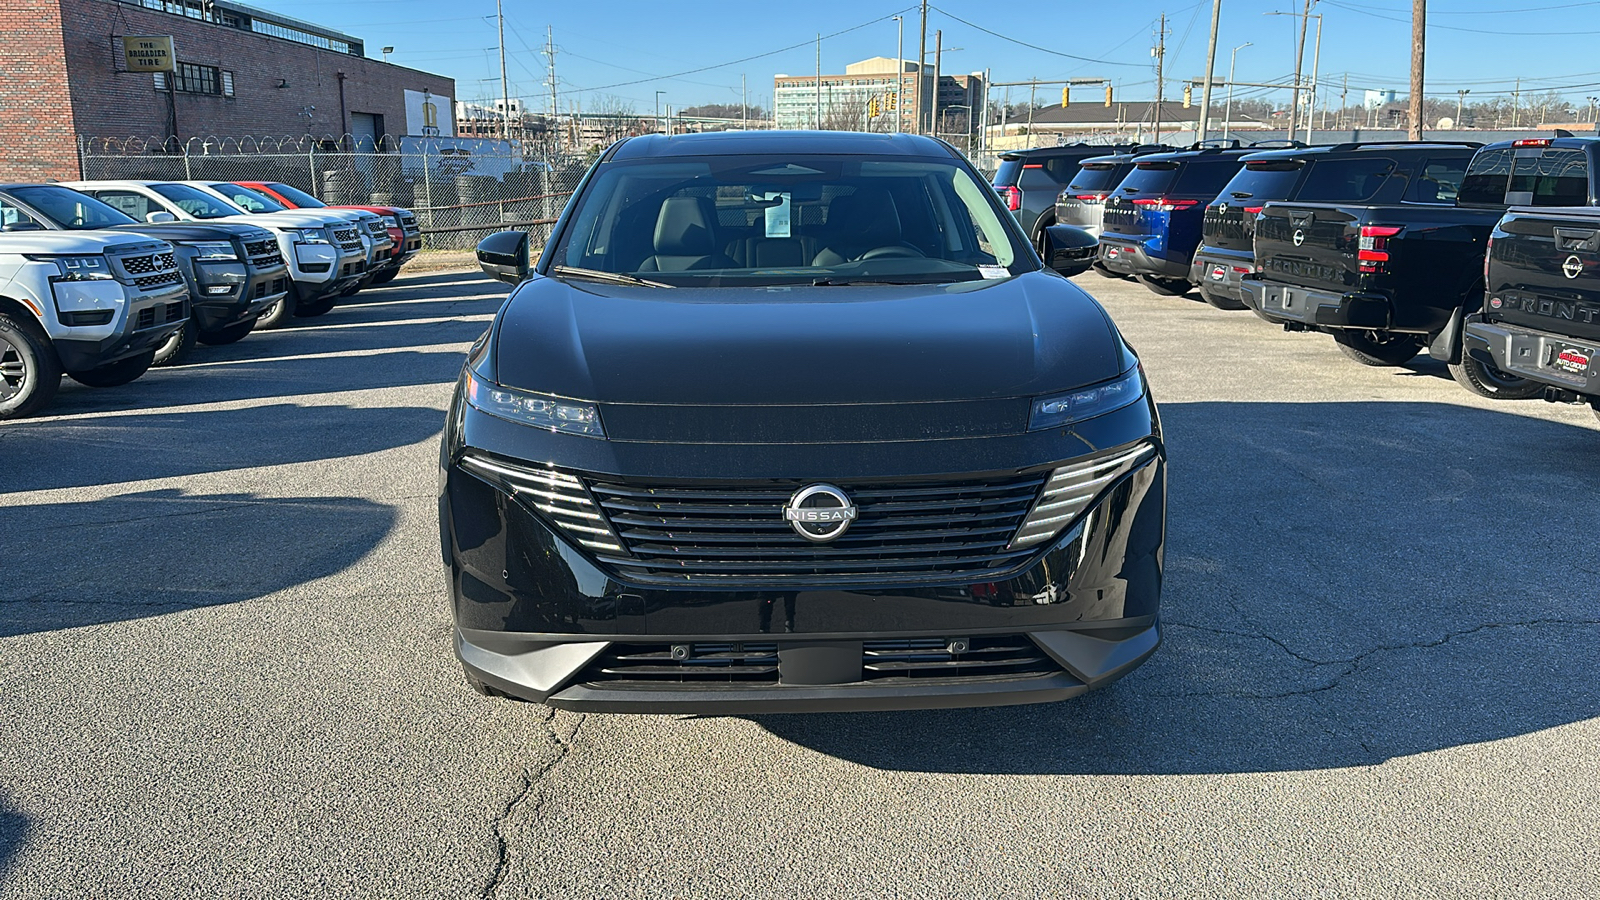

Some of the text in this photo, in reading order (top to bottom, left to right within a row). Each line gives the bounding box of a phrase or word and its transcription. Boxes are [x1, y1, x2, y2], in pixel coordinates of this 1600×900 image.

[129, 49, 166, 57] BRIGADIER
[1556, 358, 1570, 367] AUTO
[1569, 361, 1588, 371] GROUP
[1559, 352, 1587, 365] HALLMARK
[788, 509, 854, 520] NISSAN
